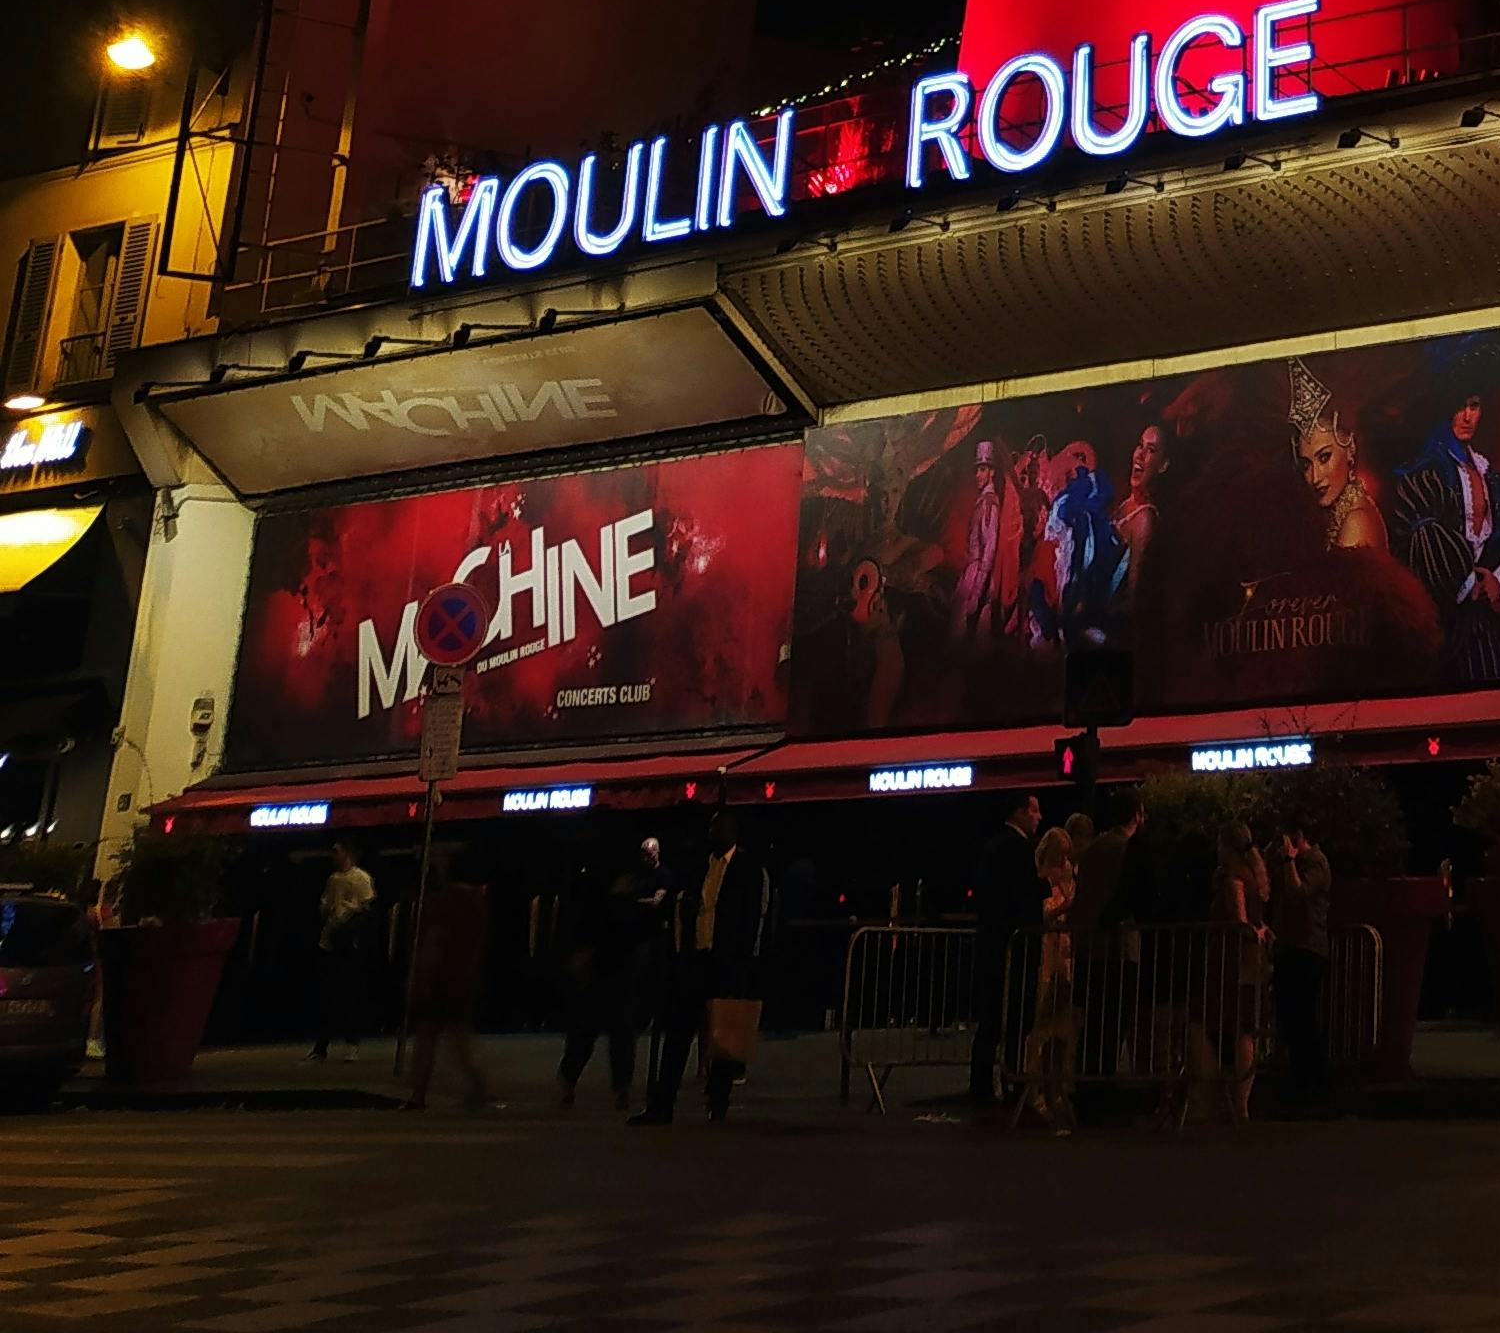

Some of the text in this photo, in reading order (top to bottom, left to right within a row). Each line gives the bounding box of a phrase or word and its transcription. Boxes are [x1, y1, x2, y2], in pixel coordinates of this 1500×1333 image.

[411, 109, 794, 288] MOULIN
[1202, 605, 1372, 661] MOULIN ROUGE
[477, 639, 546, 674] DU MOULIN ROUGE
[557, 682, 651, 708] CONCERTS CLUB
[1192, 743, 1313, 771] MOULIN ROUGE
[870, 766, 972, 792] MOULIN ROUGE
[503, 788, 592, 811] MOULIN ROUGE
